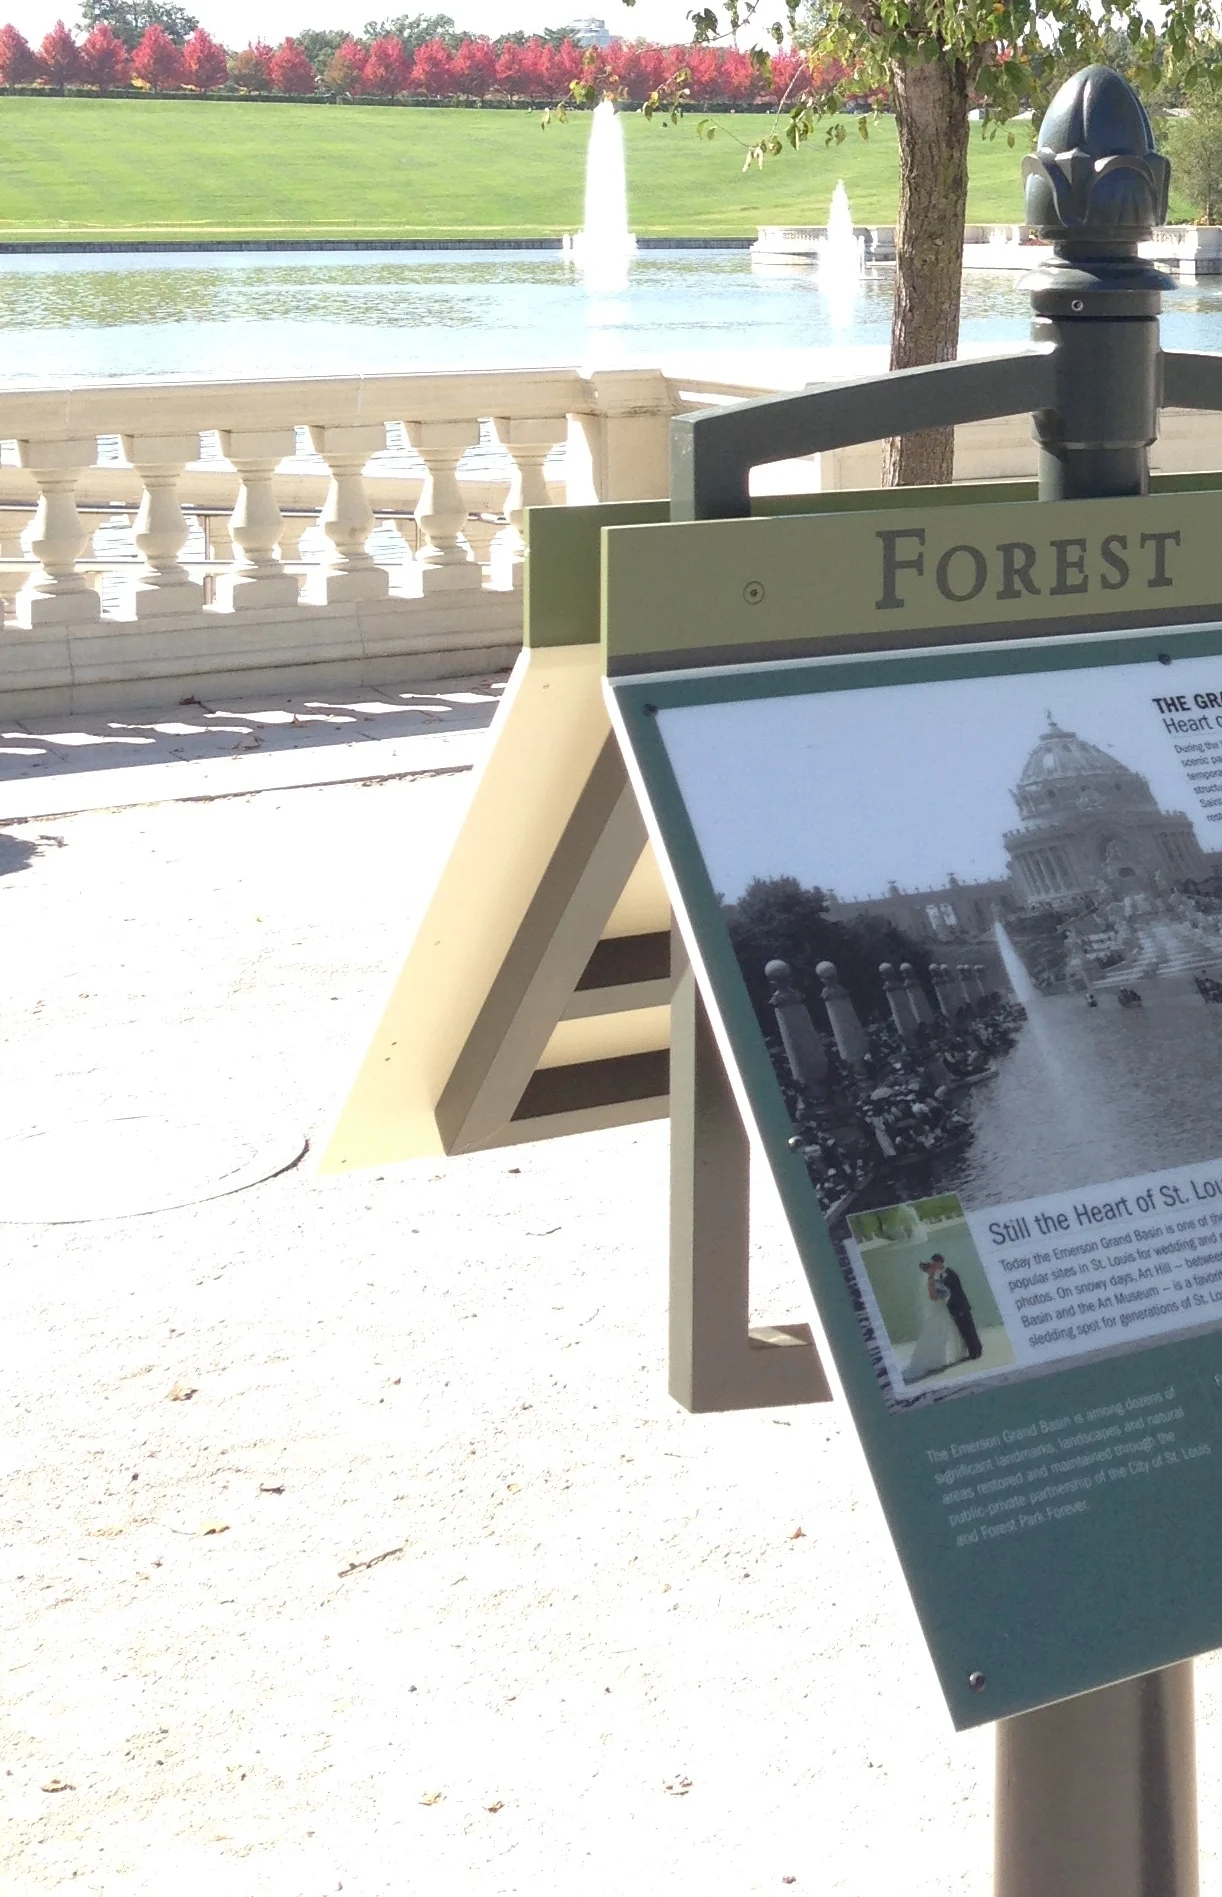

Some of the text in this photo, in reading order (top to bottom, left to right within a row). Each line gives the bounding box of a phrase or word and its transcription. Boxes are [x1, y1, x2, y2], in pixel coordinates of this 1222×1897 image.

[1151, 695, 1191, 714] THE
[1162, 714, 1213, 734] Heart
[988, 1217, 1031, 1245] Still
[1033, 1210, 1070, 1235] the
[1073, 1196, 1133, 1226] Heart
[1135, 1188, 1156, 1212] of
[1159, 1185, 1189, 1207] St.
[998, 1257, 1031, 1271] Today
[1032, 1252, 1051, 1265] the
[1051, 1241, 1099, 1260] Emerson
[1099, 1233, 1133, 1249] Grand
[1133, 1227, 1163, 1242] Basin
[1165, 1224, 1175, 1234] is
[1176, 1220, 1196, 1232] one
[1197, 1214, 1209, 1227] of
